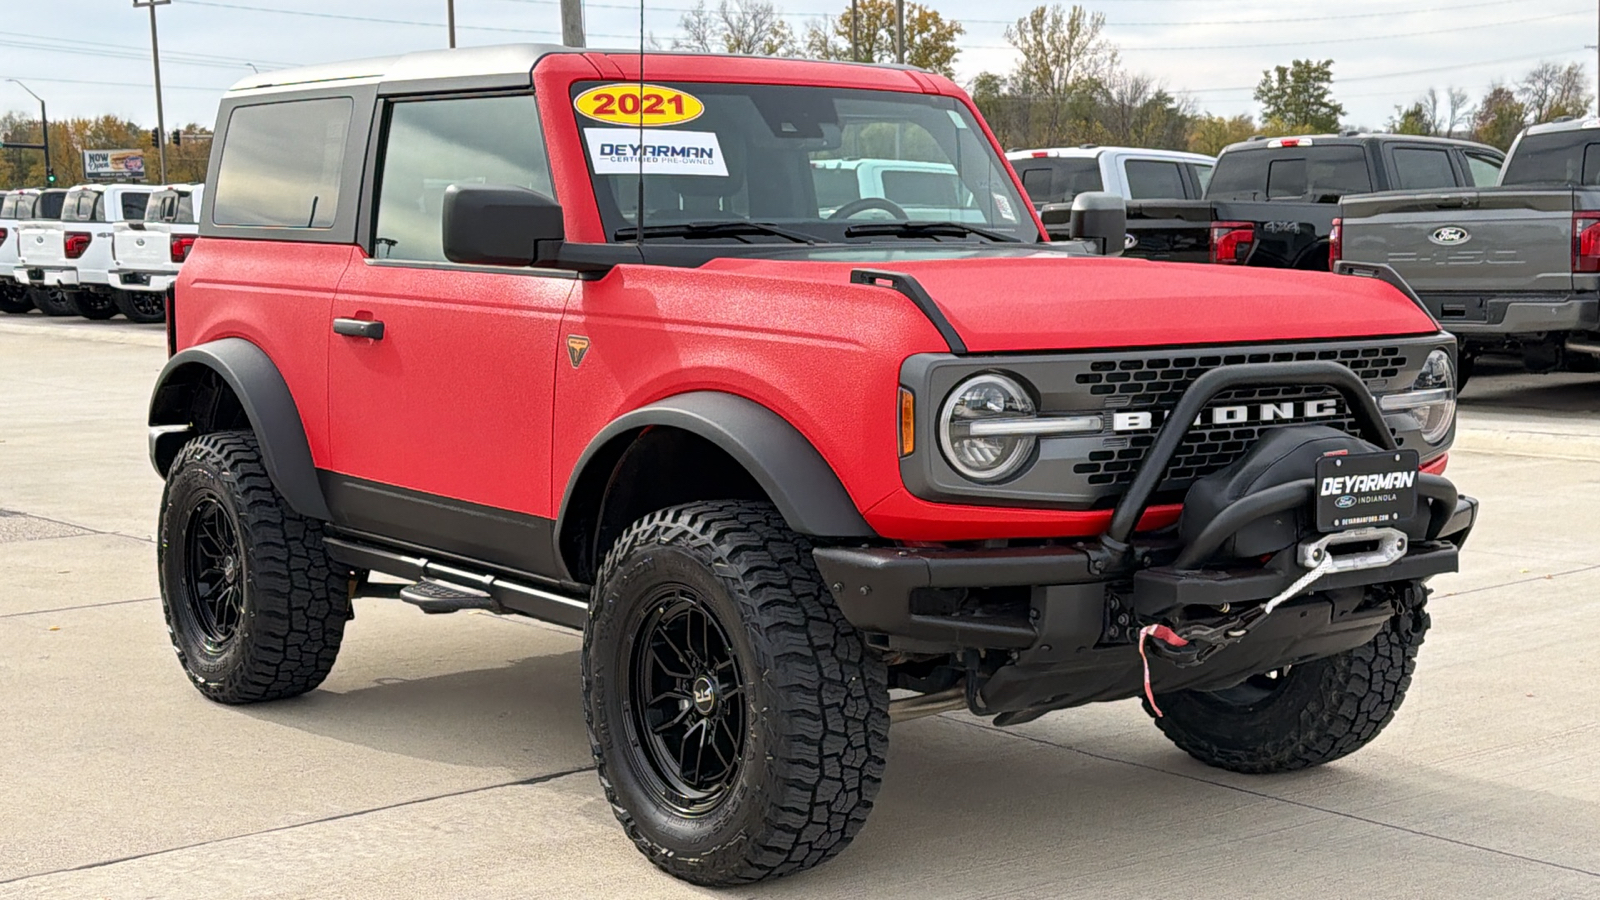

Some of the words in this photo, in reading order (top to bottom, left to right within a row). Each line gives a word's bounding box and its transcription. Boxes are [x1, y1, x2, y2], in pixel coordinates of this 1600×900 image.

[592, 93, 684, 115] 2021
[88, 153, 109, 163] NOW
[600, 143, 714, 159] DEYARMAN
[88, 160, 110, 172] Open
[661, 157, 714, 166] PRE-OWNED
[1387, 251, 1526, 266] F-150
[1113, 399, 1351, 432] BONC
[1320, 470, 1415, 497] DEYARMAN
[1357, 493, 1397, 504] INDIANOLA
